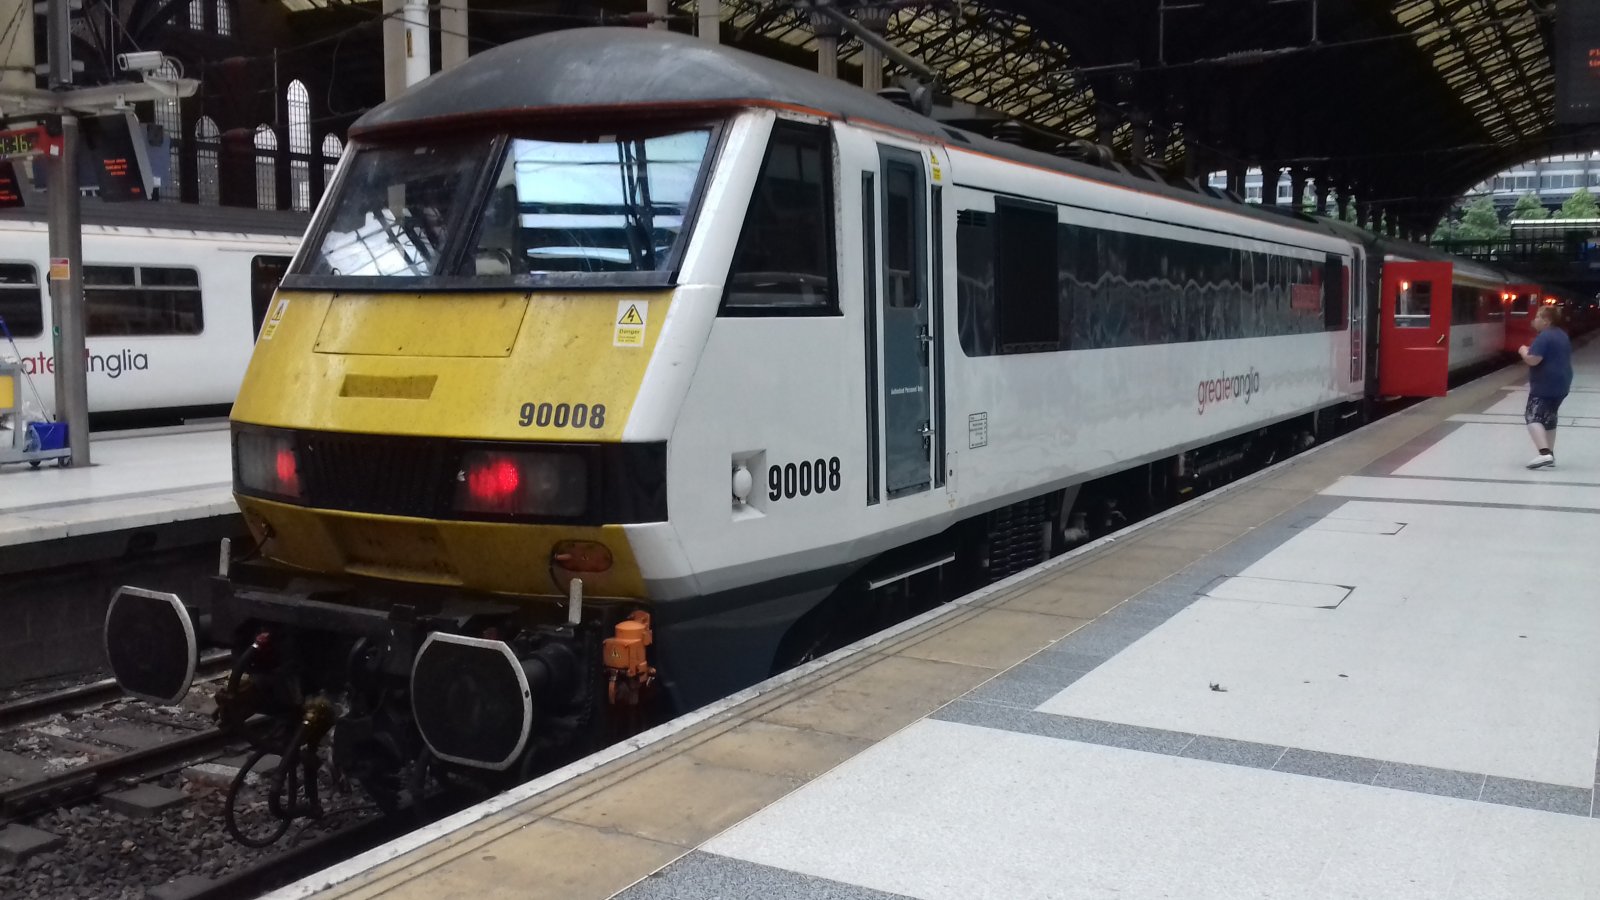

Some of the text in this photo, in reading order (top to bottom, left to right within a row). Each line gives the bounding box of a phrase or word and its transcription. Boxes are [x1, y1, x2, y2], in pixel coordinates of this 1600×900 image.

[1197, 366, 1260, 415] greateranglia
[518, 402, 606, 429] 90008
[768, 456, 841, 502] 90008
